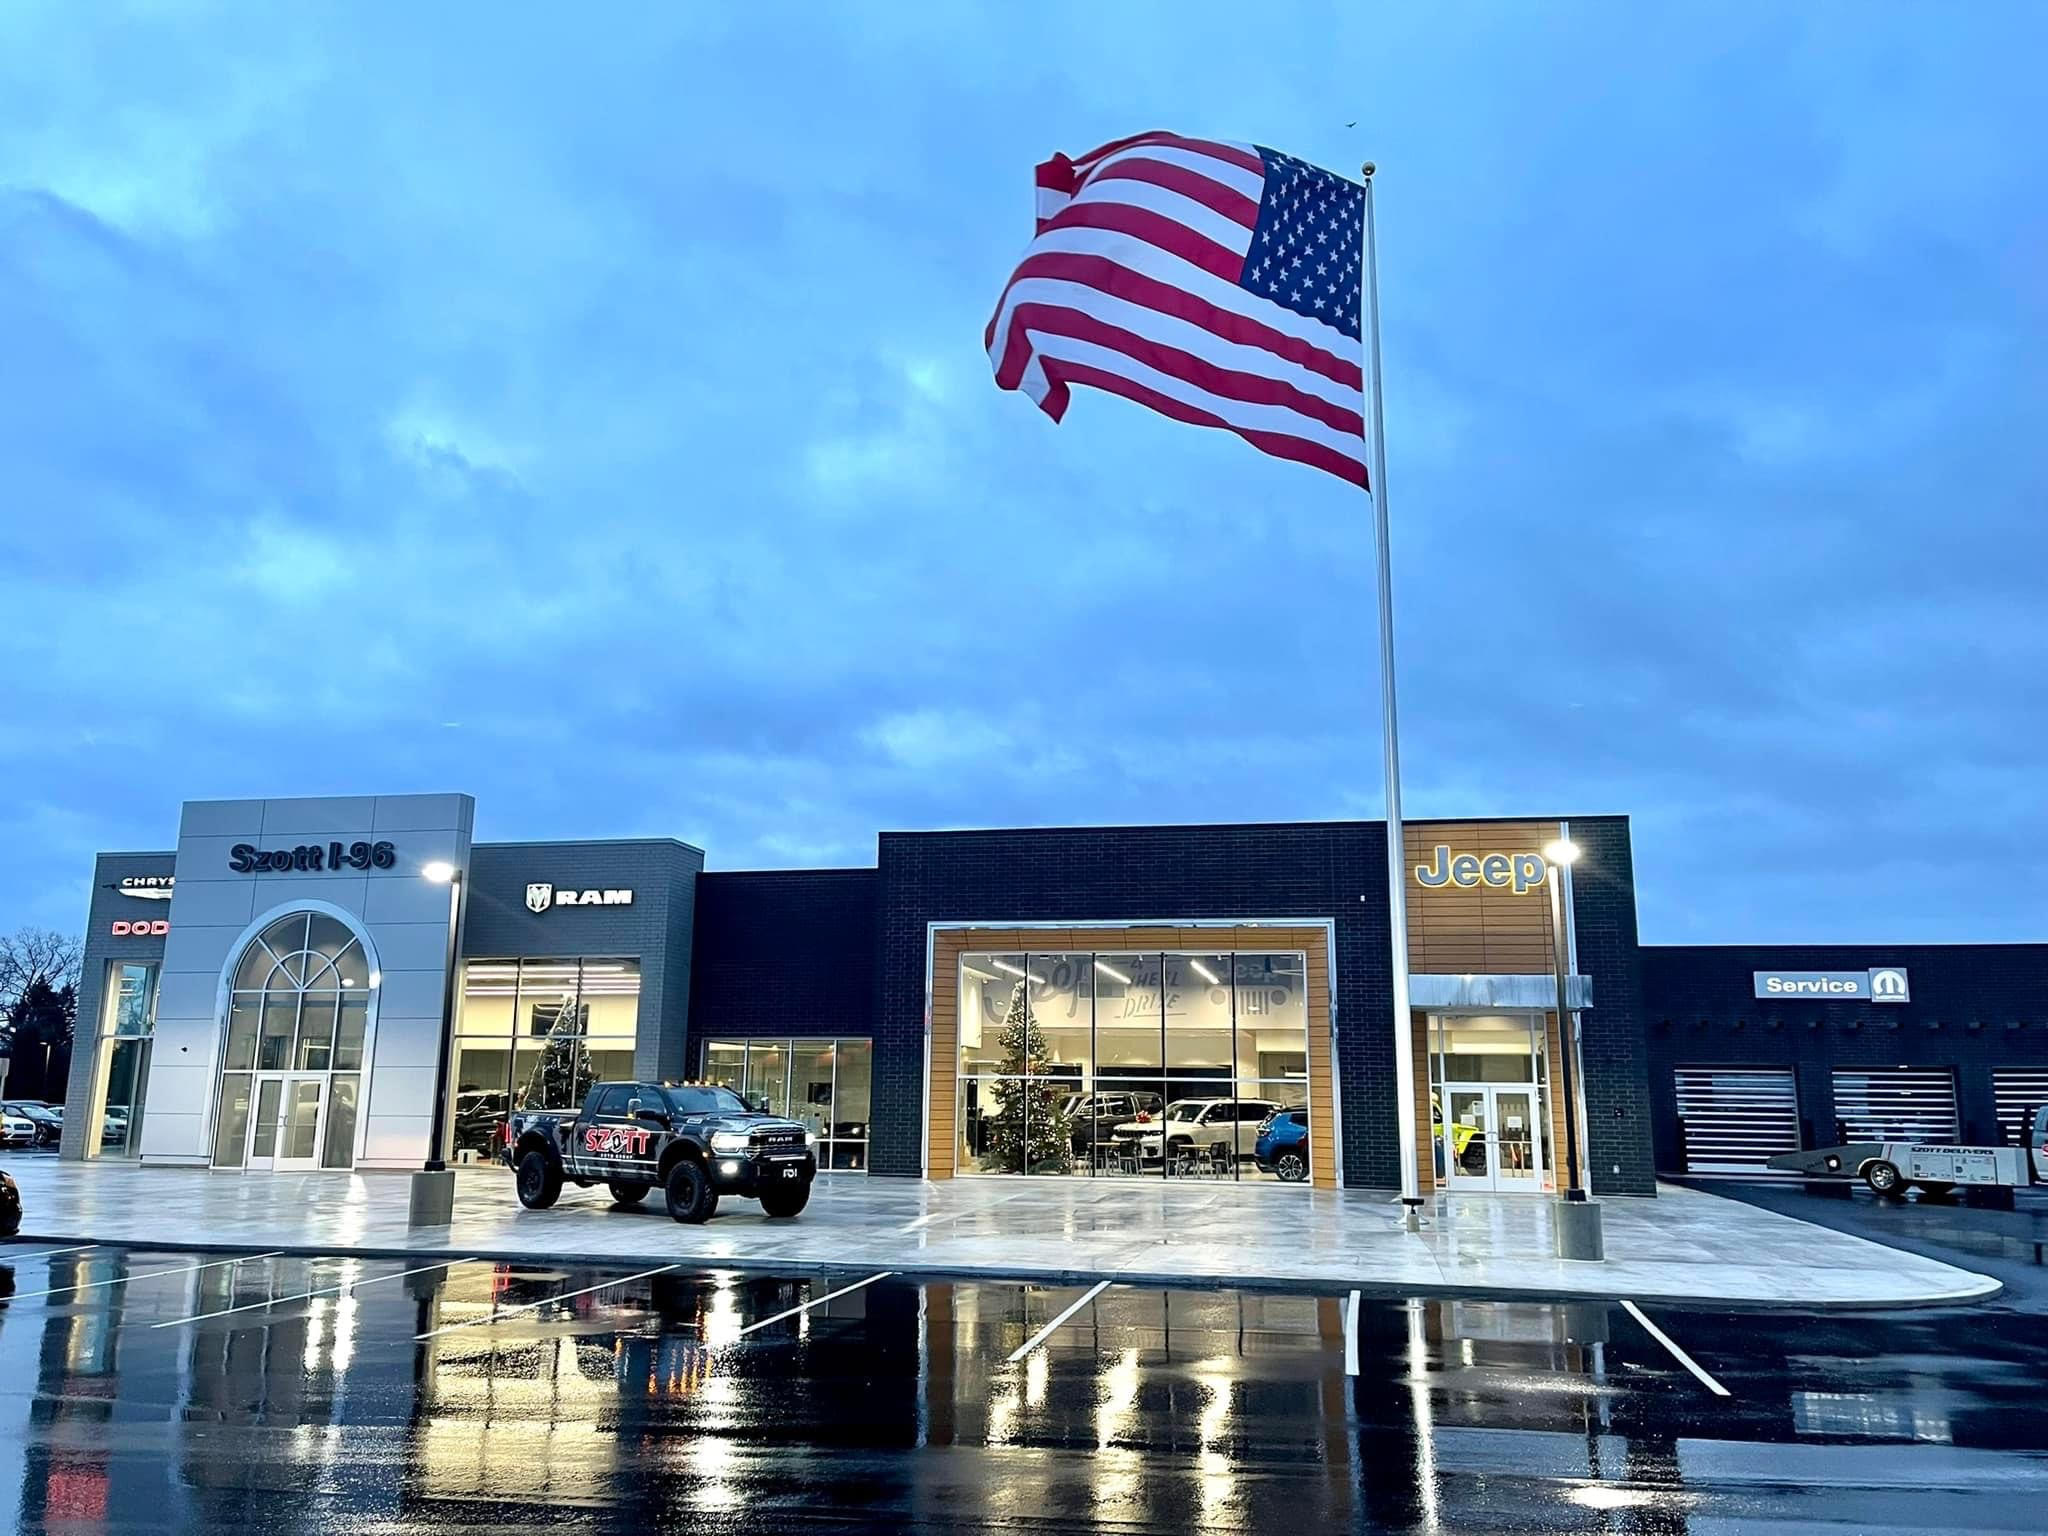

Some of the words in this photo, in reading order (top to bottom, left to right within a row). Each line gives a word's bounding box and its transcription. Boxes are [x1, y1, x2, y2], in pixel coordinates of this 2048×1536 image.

[229, 843, 323, 873] Szott
[327, 841, 394, 870] I-96
[1415, 845, 1546, 894] Jeep
[556, 889, 633, 905] RAM
[112, 920, 169, 936] DOD
[1766, 976, 1858, 993] Service
[585, 1128, 651, 1155] SZOTT
